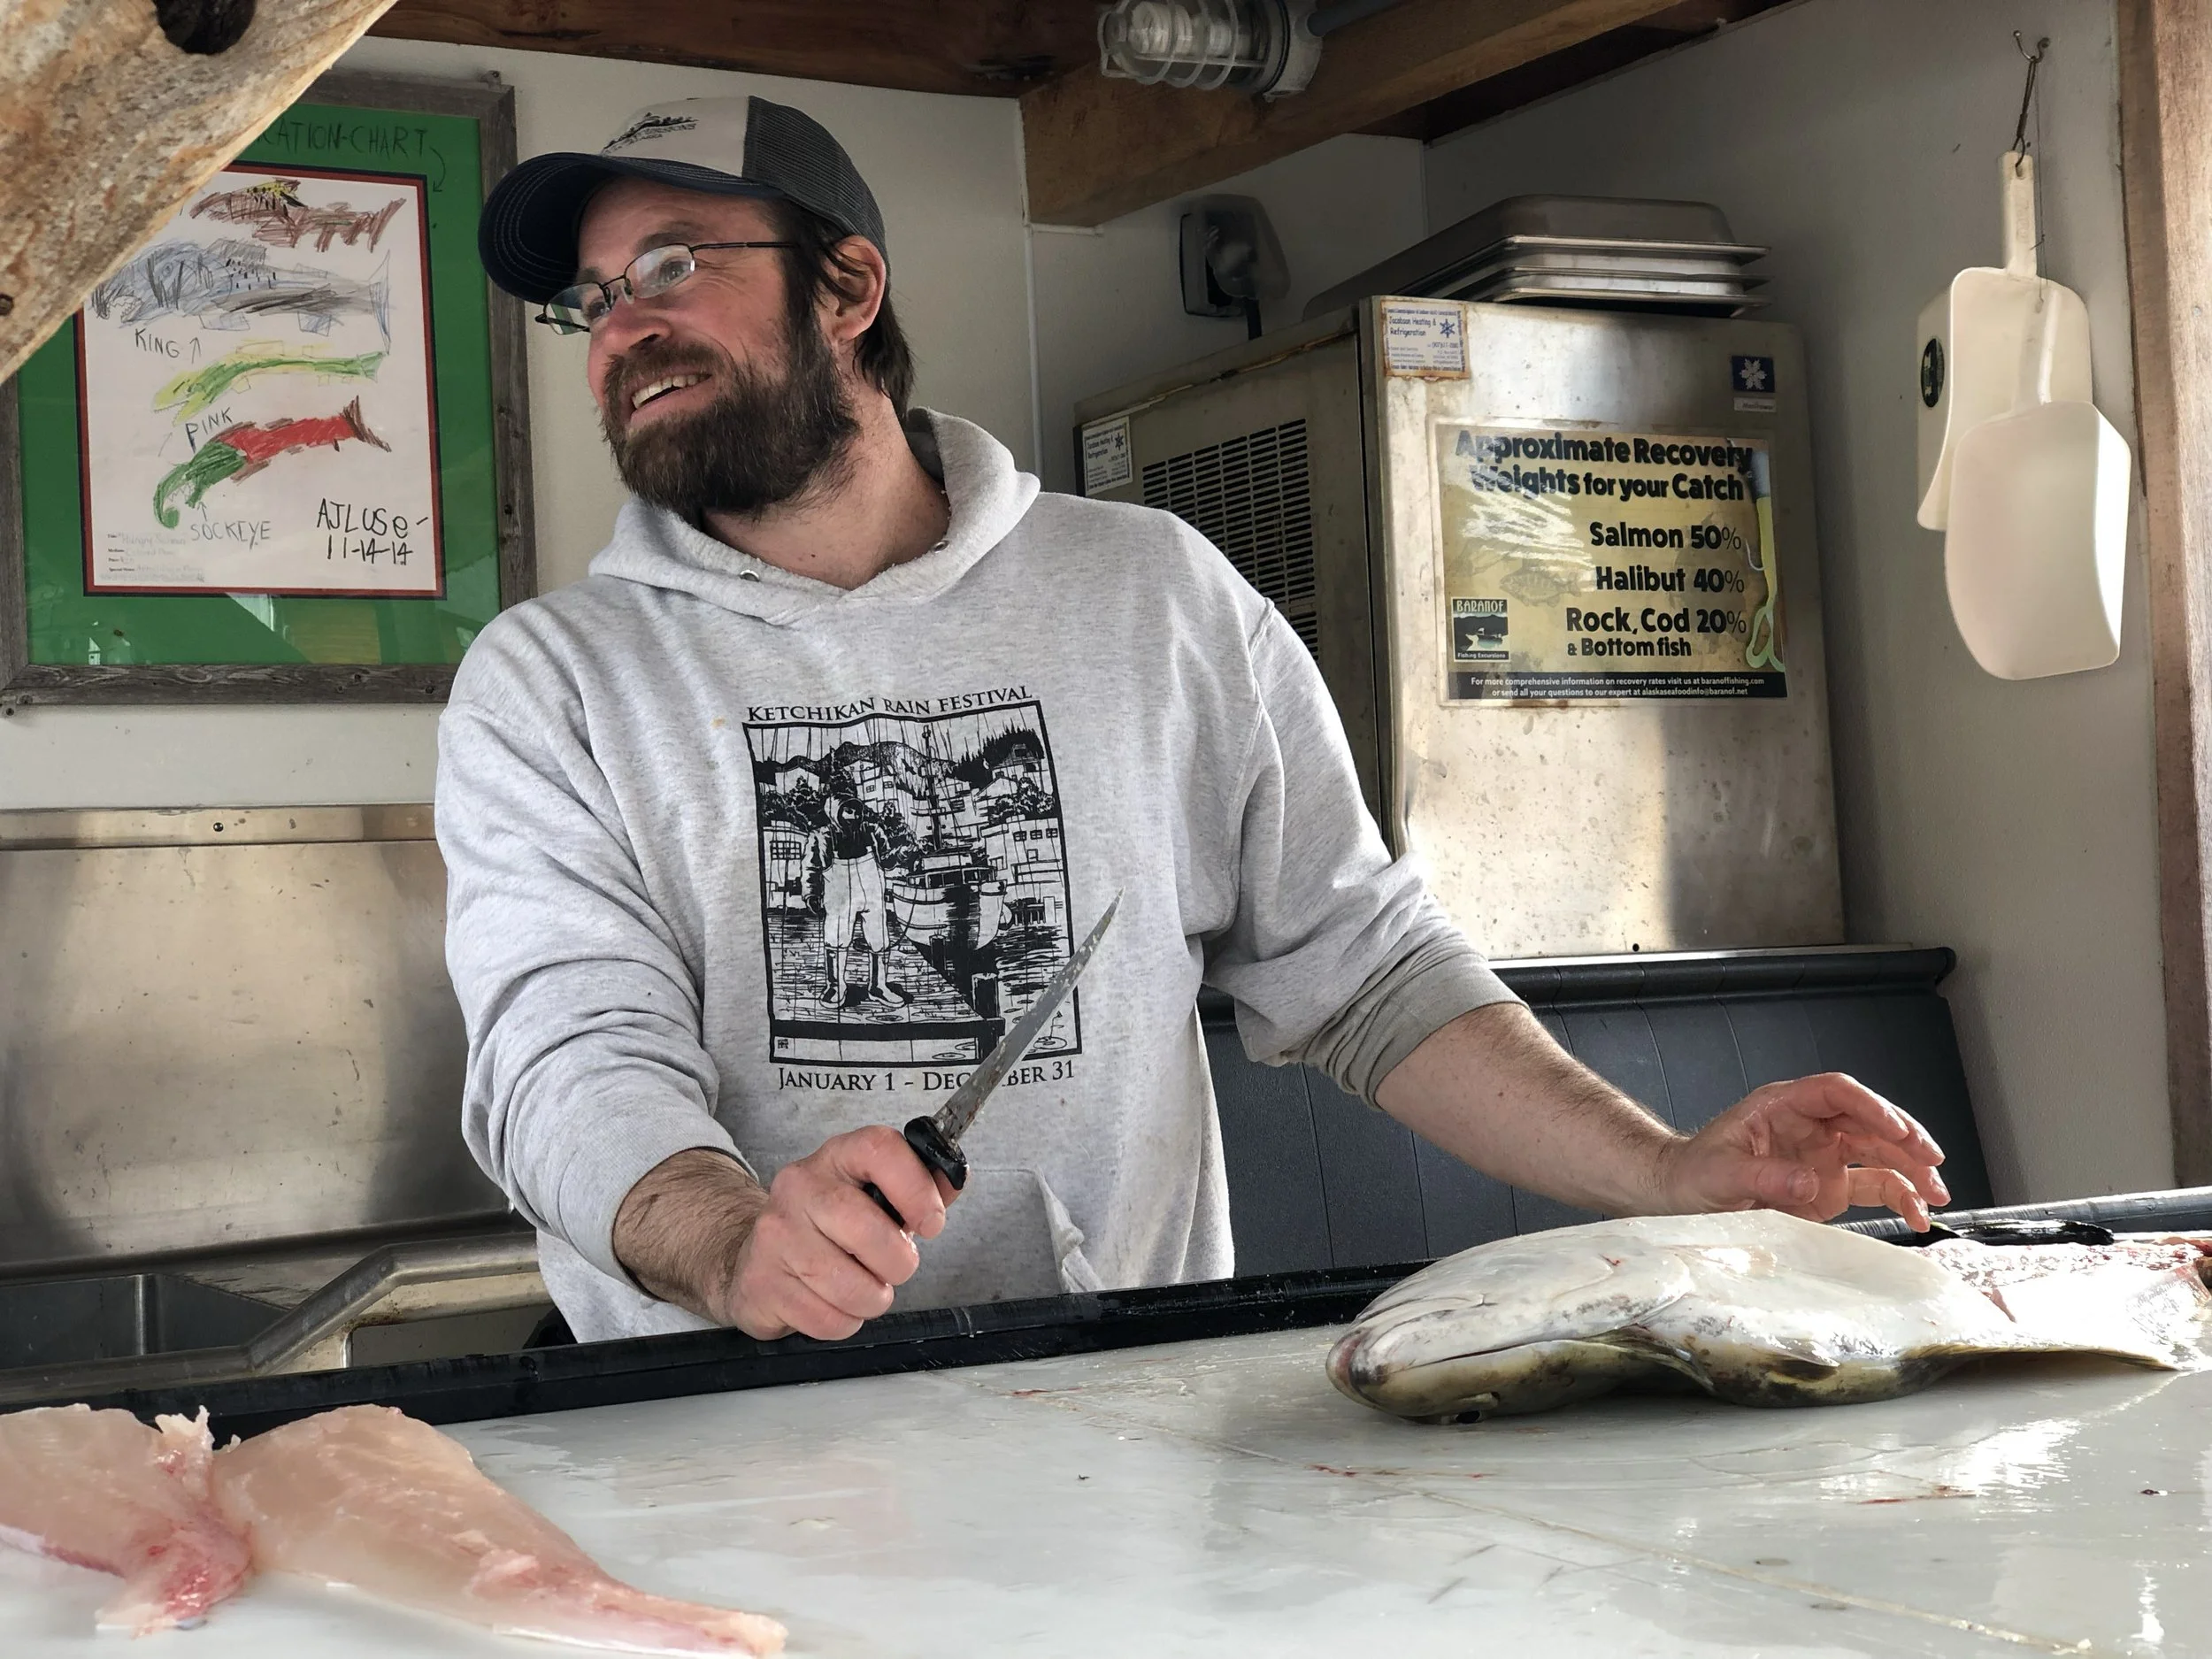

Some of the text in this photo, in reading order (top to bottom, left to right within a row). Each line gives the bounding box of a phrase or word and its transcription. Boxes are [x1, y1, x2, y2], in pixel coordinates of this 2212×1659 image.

[135, 328, 180, 358] KING
[186, 407, 233, 453] PINK
[1455, 430, 1753, 473] Approximate Recovery
[1583, 472, 1616, 495] for
[1619, 477, 1669, 502] your
[1672, 473, 1744, 501] Catch
[1590, 522, 1741, 549] Salmon 50%
[1596, 565, 1745, 593] Halibut 40%
[1456, 600, 1504, 612] BARANOF
[1566, 606, 1747, 635] Rock, Cod 20%
[1567, 636, 1692, 657] & Bottom fish
[1471, 677, 1484, 686] For
[1505, 677, 1560, 687] comprehensive
[1562, 677, 1603, 686] information
[1617, 678, 1647, 687] recovery
[1701, 677, 1764, 687] baranoffishing.com
[1548, 688, 1584, 697] questions
[1608, 688, 1632, 697] expert
[1642, 687, 1747, 696] alaskaseafoodinfo@baranof.net
[746, 685, 1033, 722] KETCHIKAN RAIN FESTIVAL
[779, 1068, 877, 1091] JANUARY
[885, 1072, 895, 1091] 1
[923, 1065, 1047, 1091] DECBER
[1052, 1060, 1074, 1081] 31
